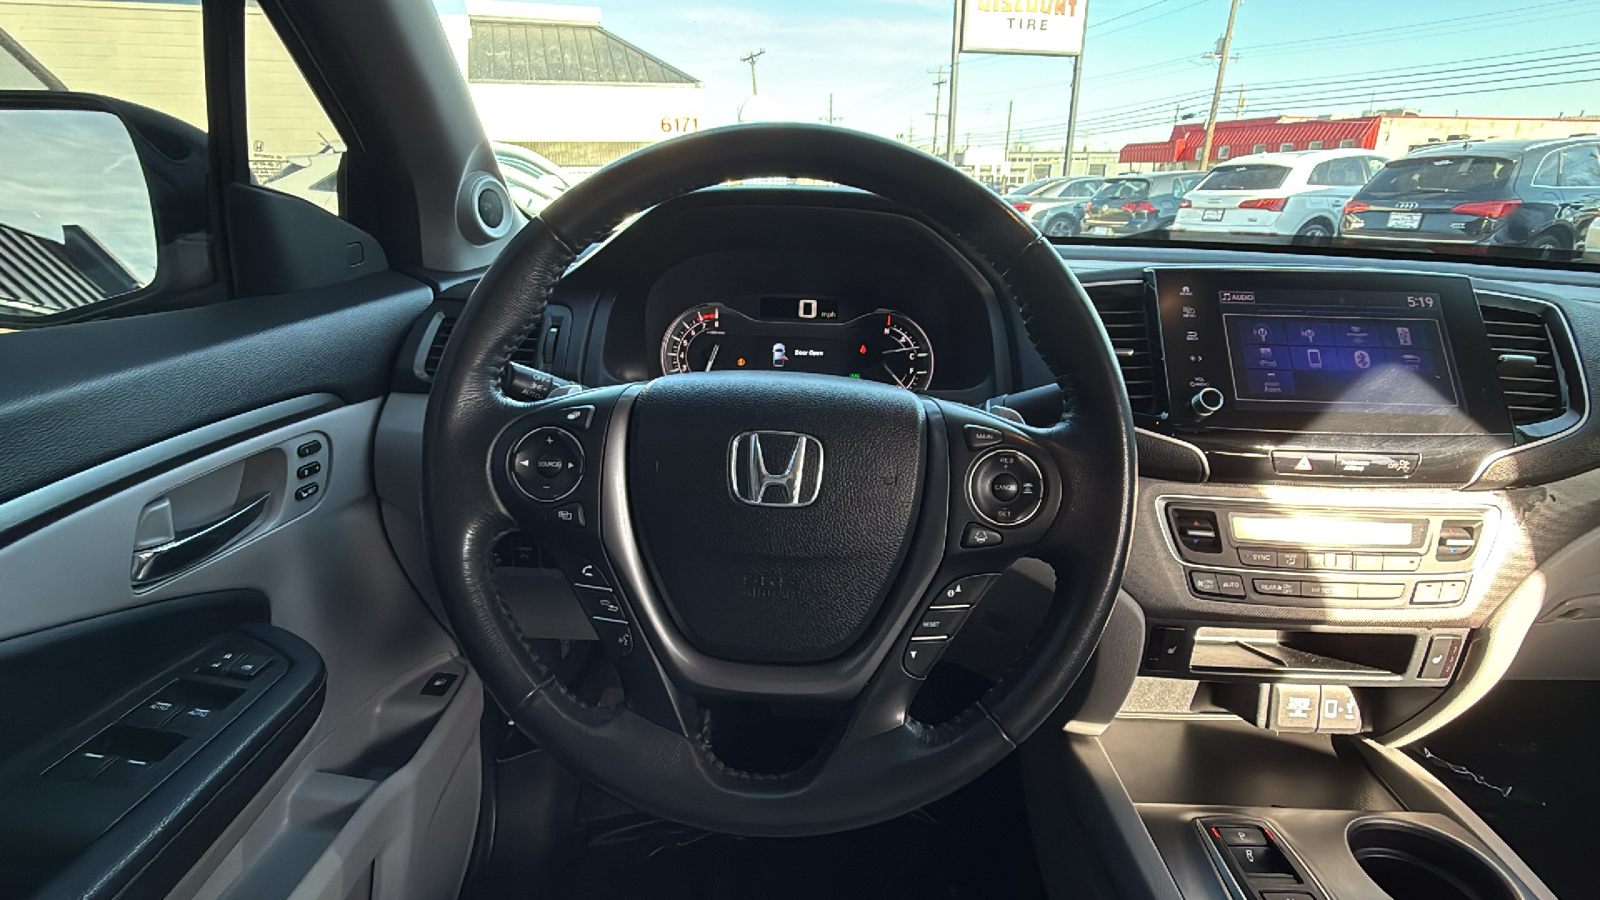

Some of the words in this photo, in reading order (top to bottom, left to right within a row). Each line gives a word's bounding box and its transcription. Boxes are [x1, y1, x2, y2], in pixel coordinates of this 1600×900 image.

[1007, 18, 1048, 30] TIRE
[661, 116, 697, 132] 6171
[1407, 296, 1434, 308] 5:19
[798, 299, 818, 318] 0
[821, 311, 837, 319] mph
[683, 339, 688, 347] 5
[680, 351, 685, 359] 4
[809, 349, 824, 357] Open
[1261, 583, 1277, 591] REAR
[1238, 831, 1246, 840] P
[1245, 849, 1252, 858] R
